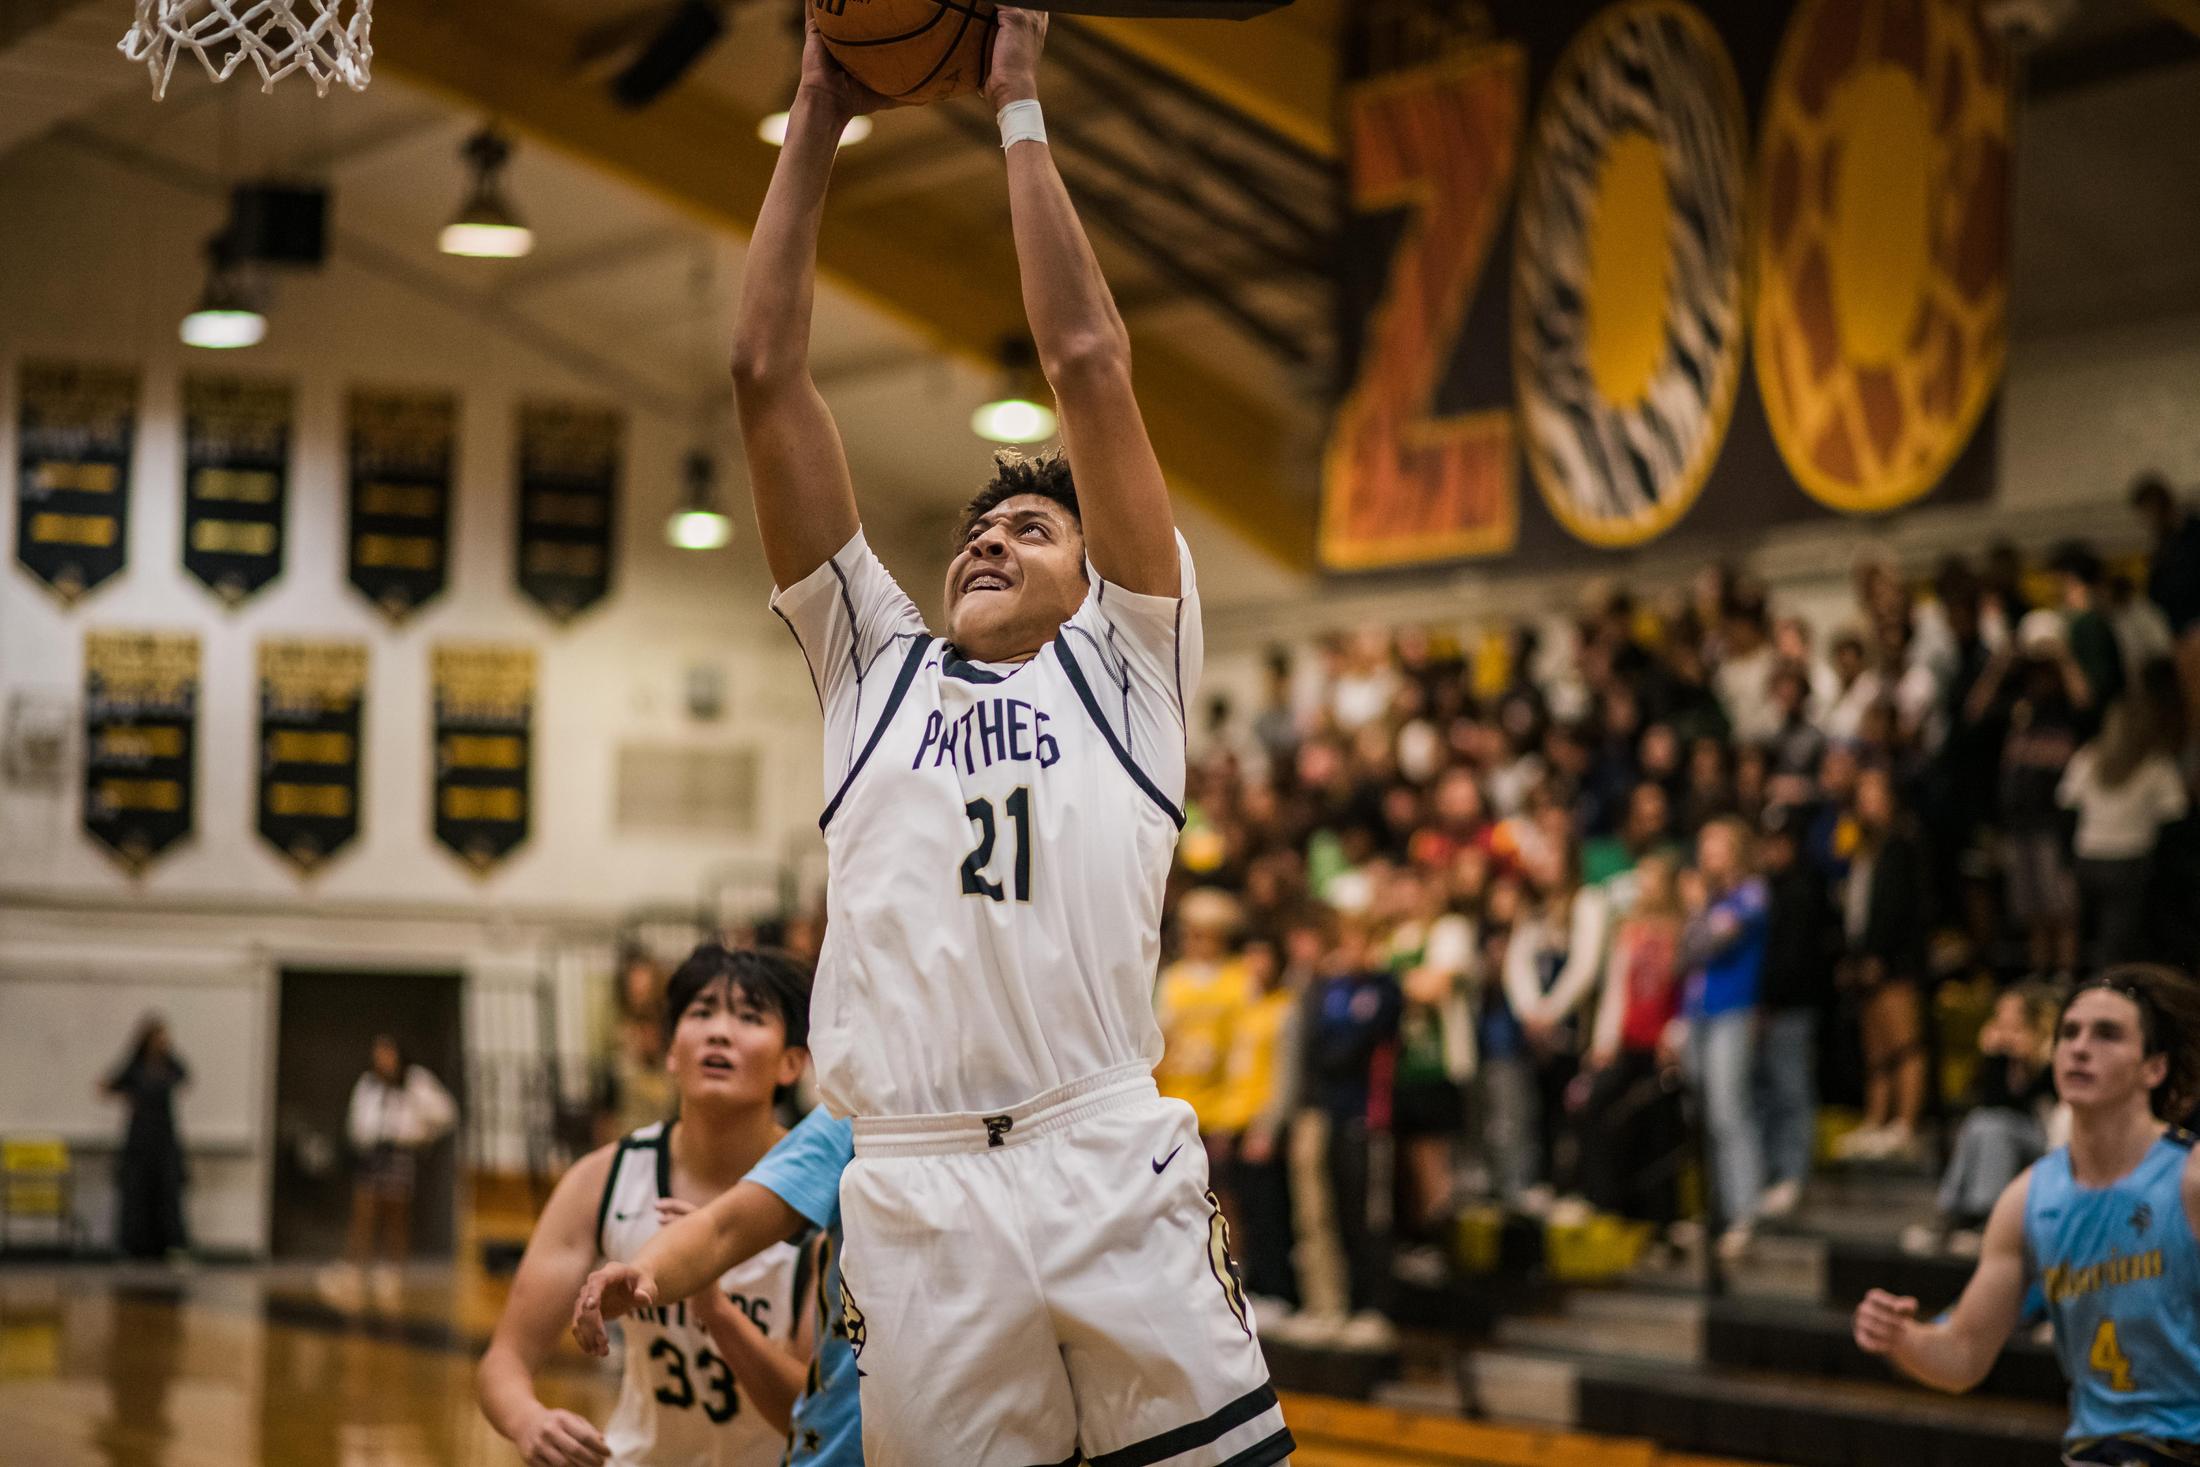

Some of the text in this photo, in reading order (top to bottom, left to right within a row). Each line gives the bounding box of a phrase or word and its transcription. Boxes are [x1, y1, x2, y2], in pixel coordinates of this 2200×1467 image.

[1320, 0, 2012, 570] ZOO
[960, 785, 1034, 904] 21
[982, 1114, 1013, 1147] P
[650, 1337, 739, 1424] 33
[2089, 1318, 2135, 1393] 4
